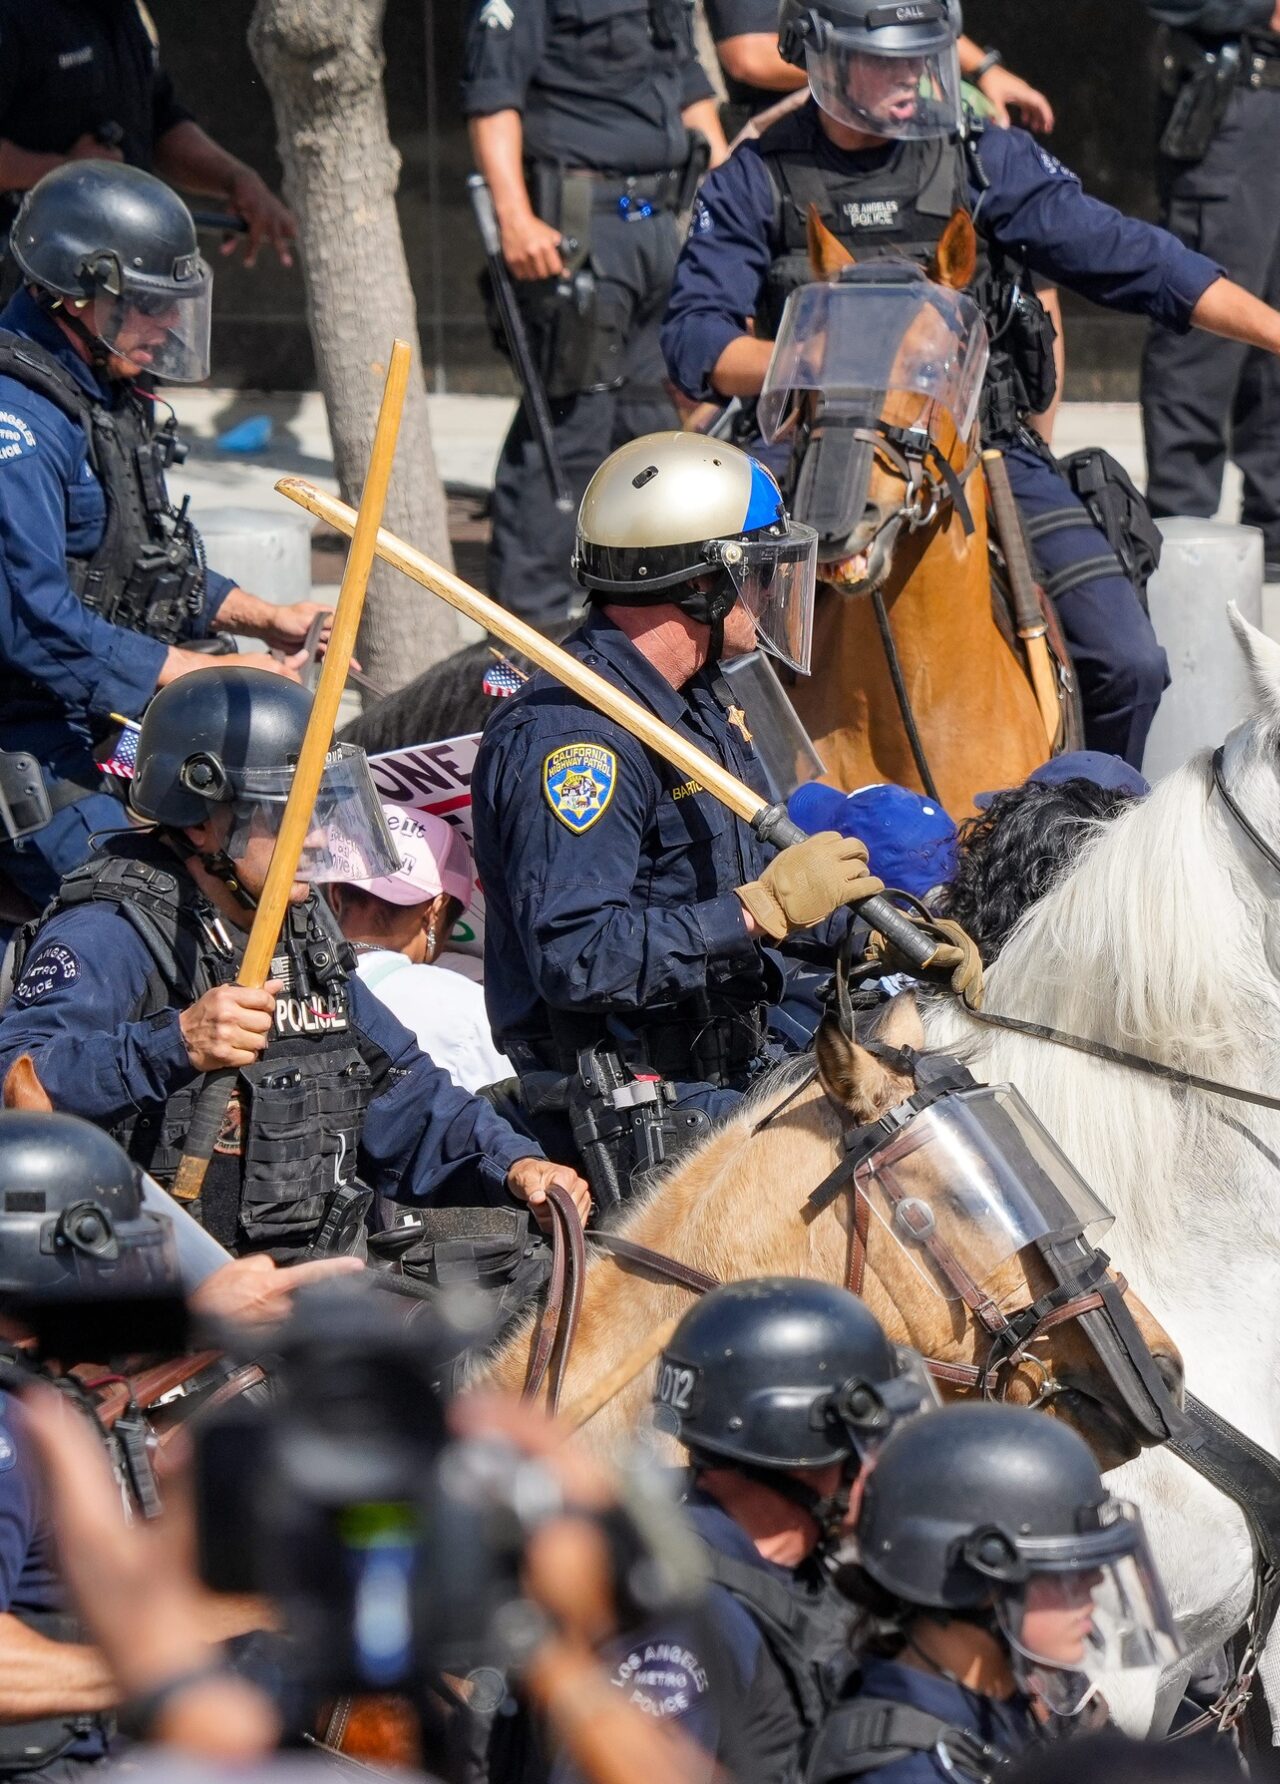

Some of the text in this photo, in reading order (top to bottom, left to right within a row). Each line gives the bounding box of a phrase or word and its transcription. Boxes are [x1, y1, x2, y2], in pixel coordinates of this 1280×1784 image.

[896, 6, 923, 20] CALL
[843, 201, 898, 215] LOS ANGELES
[851, 211, 893, 227] POLICE
[552, 747, 608, 766] CALIFORNIA
[548, 756, 612, 777] HIGHWAY PATROL
[276, 996, 347, 1032] POLICE
[610, 1645, 709, 1693] LOS ANGELES
[633, 1671, 688, 1688] METRO
[629, 1689, 689, 1717] POLICE
